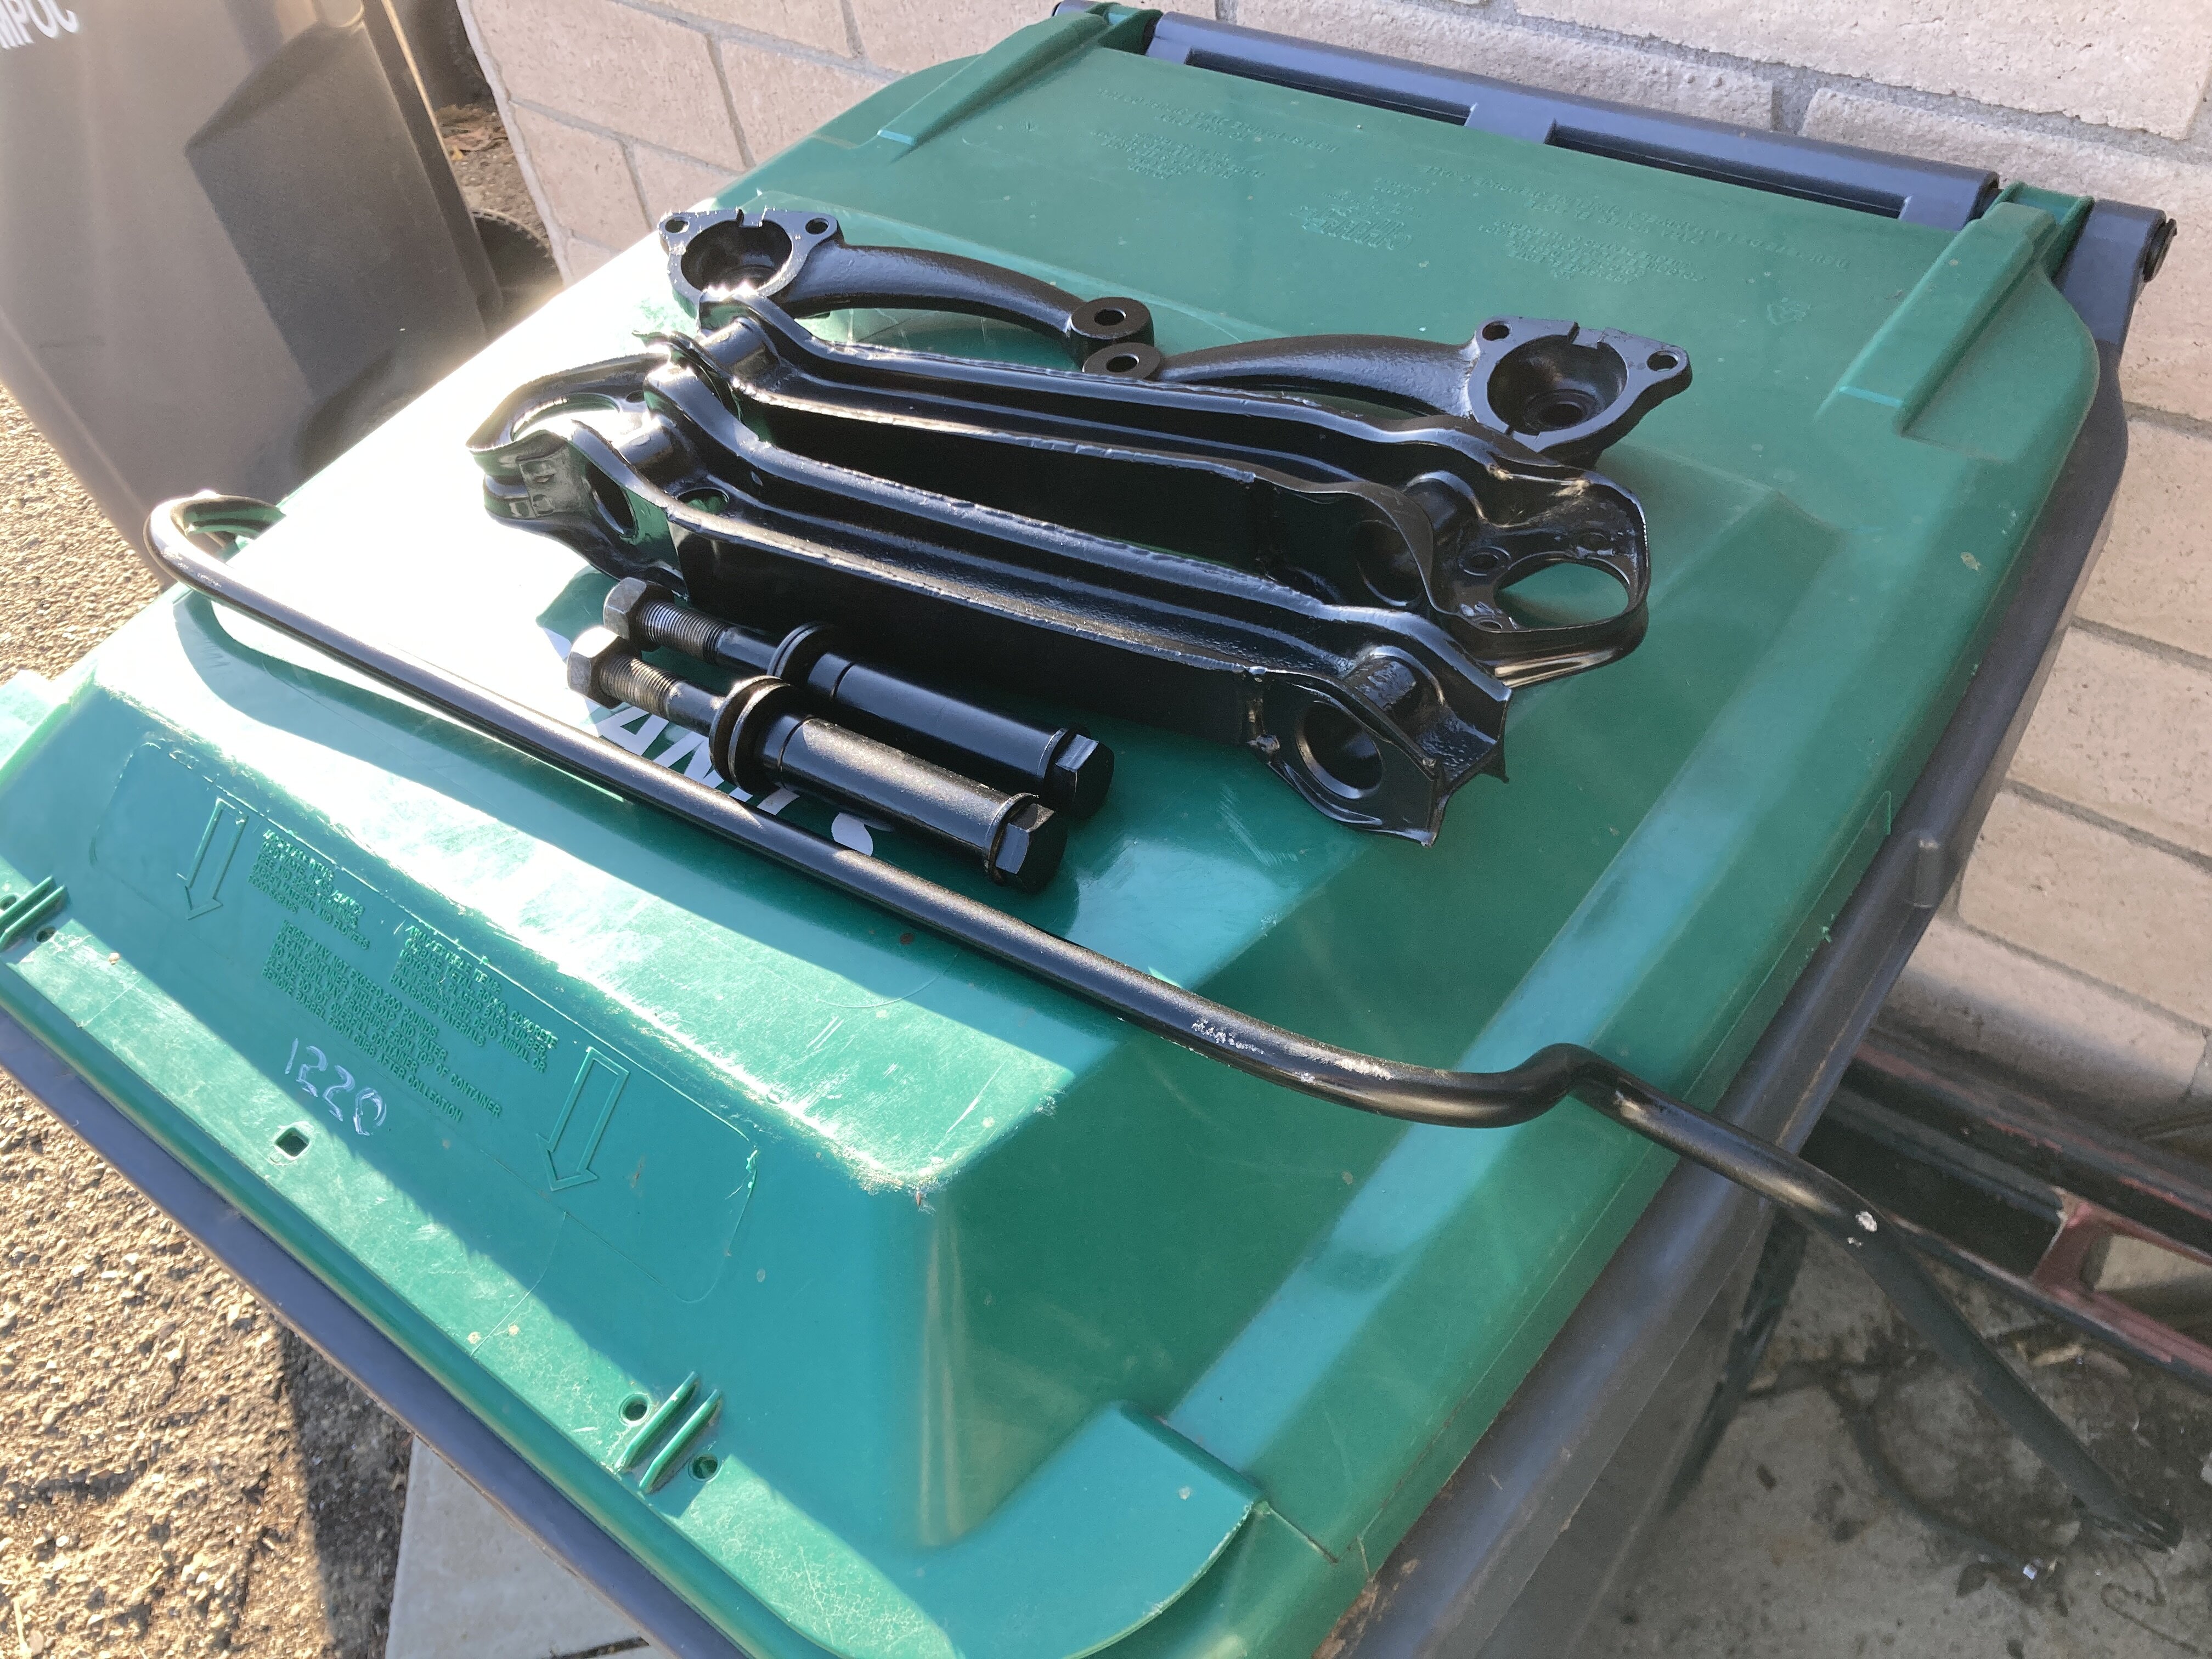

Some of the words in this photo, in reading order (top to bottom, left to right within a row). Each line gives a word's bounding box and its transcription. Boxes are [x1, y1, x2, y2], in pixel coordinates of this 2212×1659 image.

[246, 873, 269, 894] FOOD
[268, 888, 300, 915] SCRAPS
[256, 851, 275, 871] TREE
[274, 863, 292, 882] AND
[280, 917, 312, 950] WEIGHT
[311, 940, 330, 962] MAY
[329, 953, 349, 977] NOT
[349, 967, 383, 1001] EXCEED
[382, 991, 402, 1014] 200
[401, 1006, 439, 1041] POUNDS
[315, 905, 334, 924] AND
[331, 918, 370, 951] FLOWERS
[260, 964, 296, 998] REMOVE
[294, 989, 328, 1022] BARREL
[326, 1013, 353, 1041] FROM
[351, 1032, 377, 1059] CURB
[375, 1049, 407, 1081] AFTER
[406, 1073, 463, 1124] COLLECTION
[266, 952, 297, 984] PLEASE
[296, 976, 312, 995] DO
[311, 986, 329, 1008] NOT
[329, 999, 371, 1039] OVERFILL
[369, 1029, 419, 1075] CONTAINER
[270, 941, 285, 960] NO
[284, 951, 324, 989] MATERIAL
[323, 979, 343, 1002] MAY
[341, 992, 388, 1036] PROTRUDE
[386, 1025, 415, 1055] FROM
[414, 1045, 435, 1070] TOP
[434, 1060, 450, 1081] OF
[448, 1070, 503, 1120] CONTAINER
[275, 929, 304, 959] CLEAN
[302, 949, 349, 992] CONTAINER
[348, 982, 371, 1008] WITH
[370, 997, 397, 1026] SOAP
[394, 1015, 416, 1040] AND
[416, 1031, 448, 1064] WATER
[388, 972, 439, 1014] HAZARDOUS
[437, 1007, 487, 1048] MATERIALS
[393, 960, 416, 984] PALM
[471, 1014, 499, 1041] DEAD
[496, 1031, 532, 1064] ANIMAL
[530, 1054, 548, 1075] OR
[398, 948, 430, 977] MOTOR
[445, 980, 483, 1014] PLASTIC
[481, 1006, 510, 1034] BAGS,
[507, 1024, 549, 1061] LUMBER,
[285, 1037, 387, 1136] 1220
